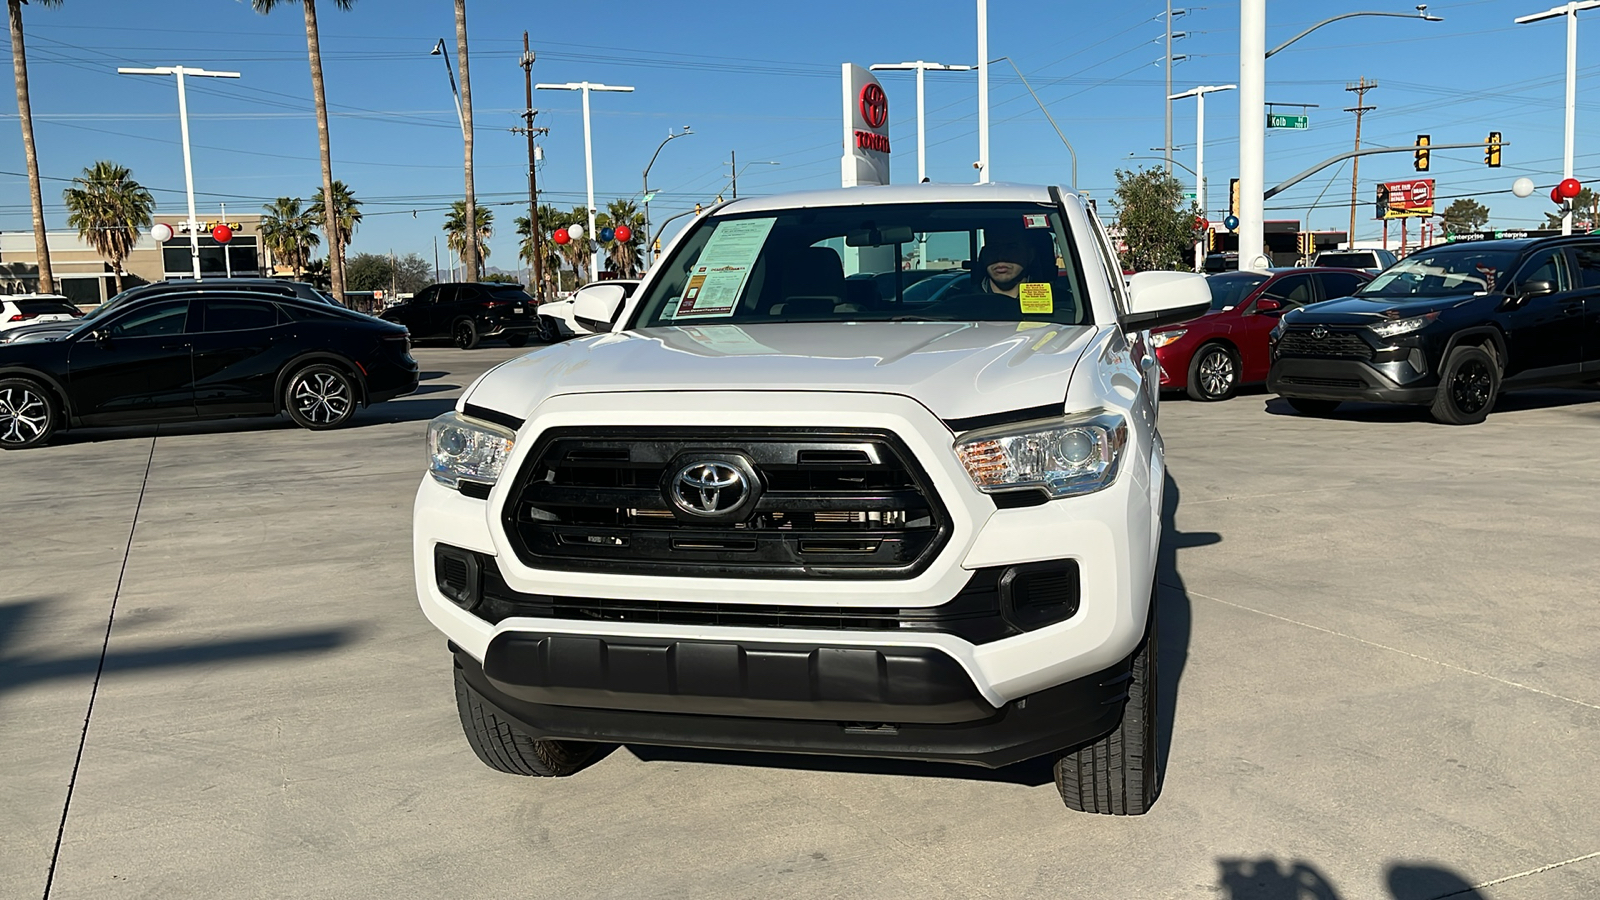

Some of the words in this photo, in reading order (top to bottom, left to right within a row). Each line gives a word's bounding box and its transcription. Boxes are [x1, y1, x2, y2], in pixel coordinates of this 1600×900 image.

[1272, 116, 1286, 126] Kolb
[854, 131, 890, 153] TOYOTA
[1448, 233, 1485, 241] enterprise
[1496, 232, 1528, 240] enterprise
